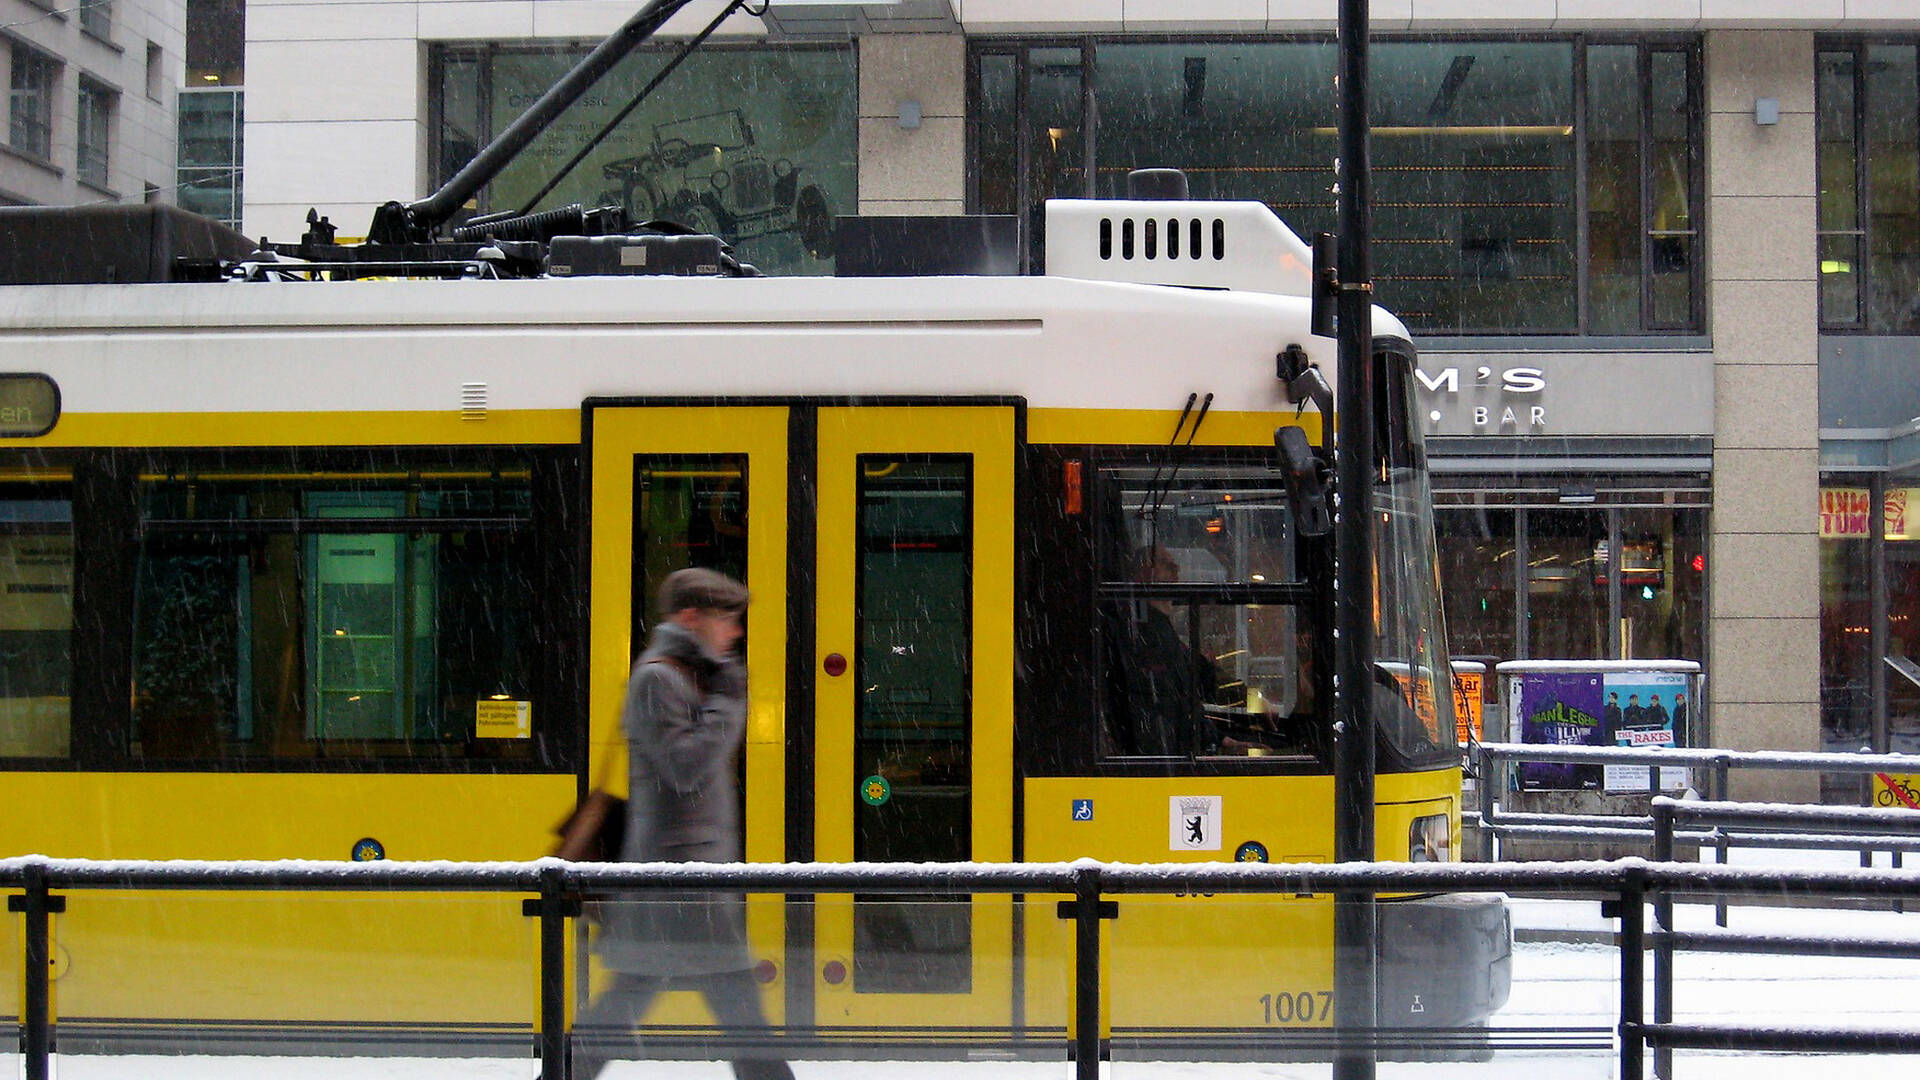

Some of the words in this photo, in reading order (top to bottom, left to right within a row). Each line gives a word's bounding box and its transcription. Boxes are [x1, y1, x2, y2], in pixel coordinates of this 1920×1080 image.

[1474, 406, 1546, 425] BAR
[1617, 731, 1632, 739] THE
[1634, 732, 1672, 743] RAKES
[1260, 990, 1334, 1024] 1007
